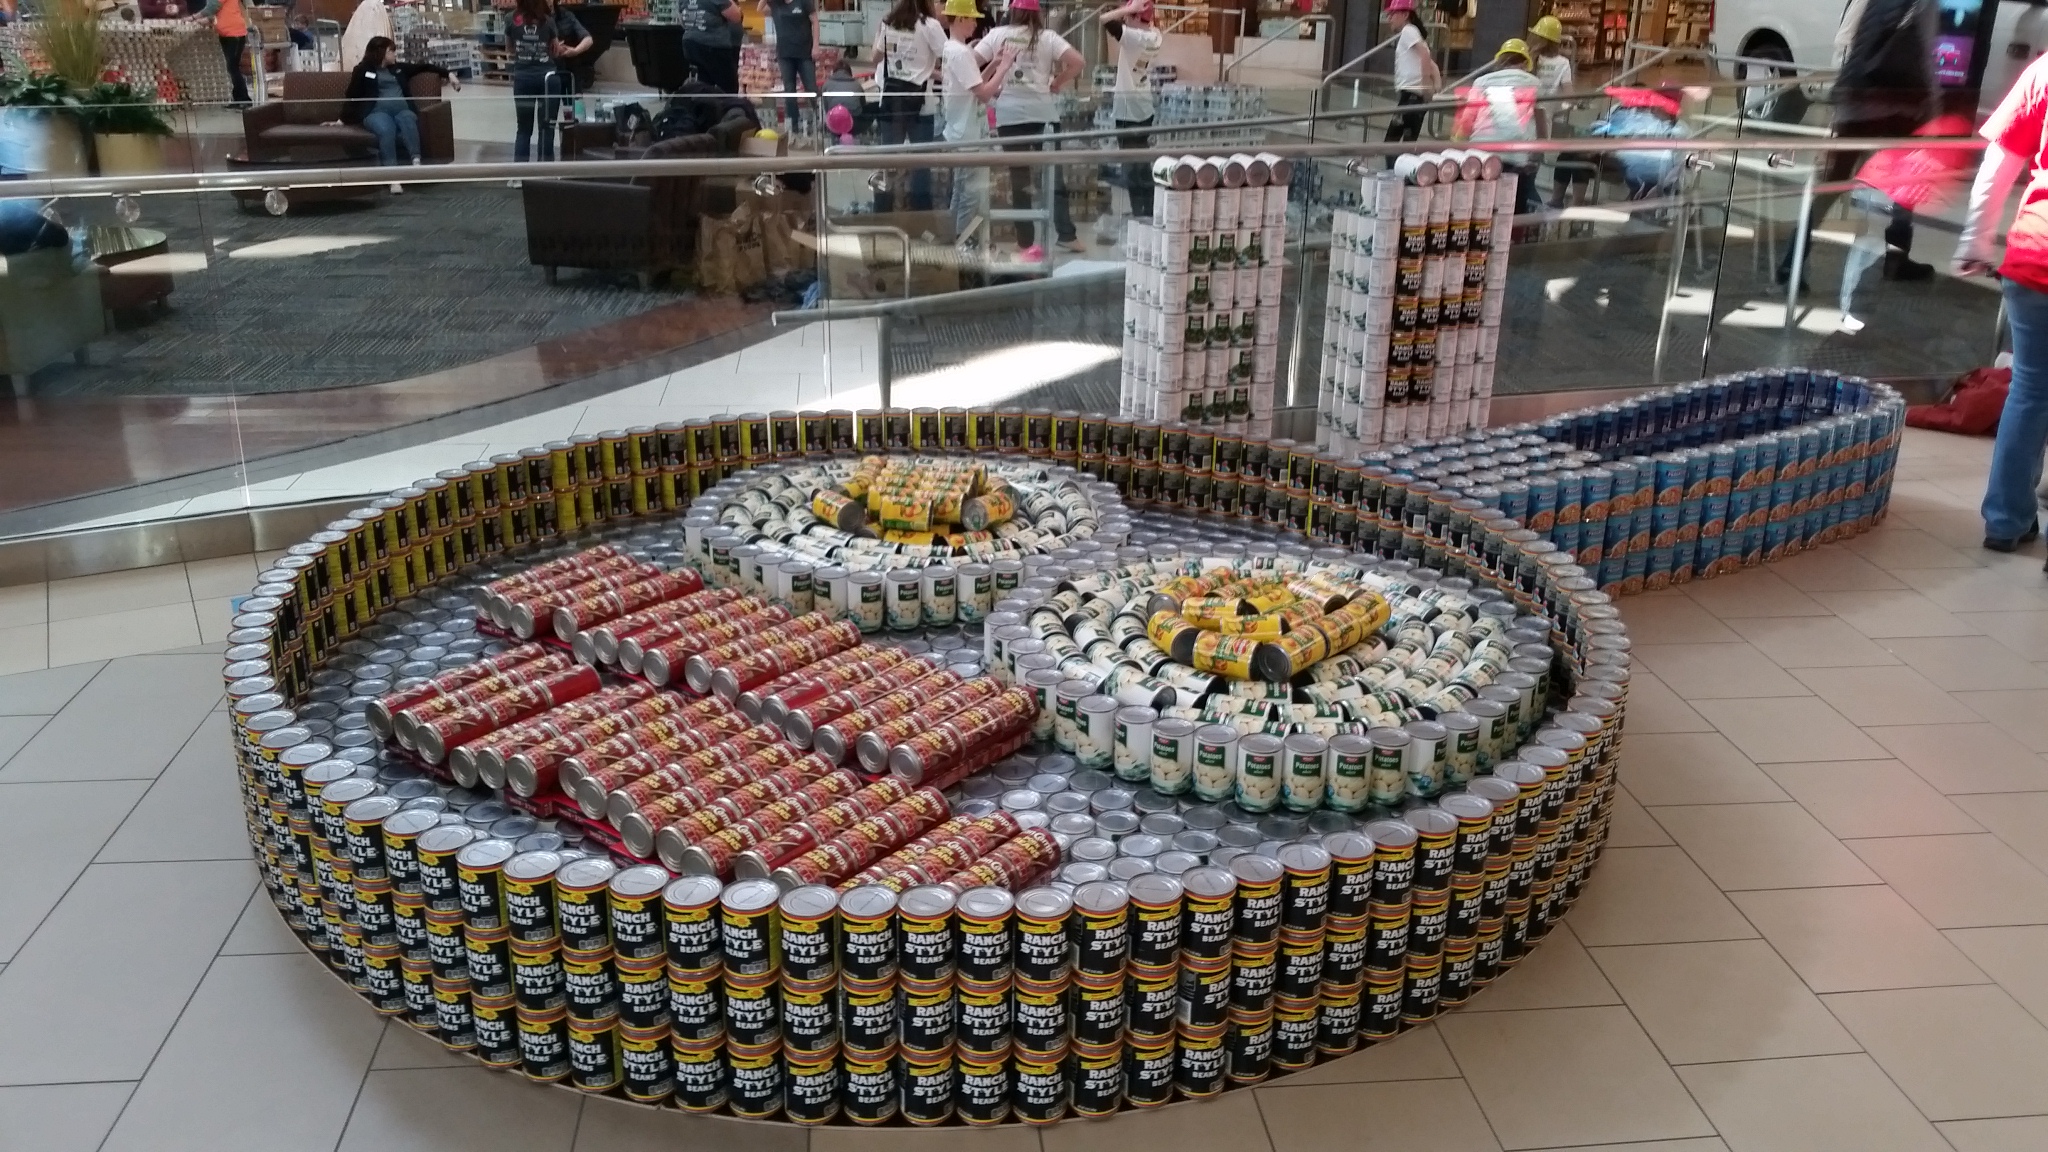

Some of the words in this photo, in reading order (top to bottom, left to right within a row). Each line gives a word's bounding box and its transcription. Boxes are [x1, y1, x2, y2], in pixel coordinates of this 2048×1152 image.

[1247, 762, 1271, 770] Potatoes
[1295, 762, 1320, 770] Potatoes
[1339, 762, 1363, 770] Potatoes
[1374, 755, 1399, 763] Potatoes
[1195, 908, 1233, 923] RANCH
[671, 918, 715, 934] RANCH
[617, 933, 642, 942] BEANS
[669, 929, 718, 943] STYLE
[783, 929, 824, 944] RANCH
[850, 929, 892, 944] RANCH
[907, 929, 950, 944] RANCH
[965, 930, 1008, 945] RANCH
[1023, 931, 1066, 945] RANCH
[1142, 928, 1180, 942] STYL
[1202, 933, 1227, 942] BEANS
[680, 943, 708, 953] BEANS
[782, 940, 828, 955] STYLE
[847, 939, 895, 954] STYLE
[905, 939, 952, 954] STYLE
[963, 942, 1010, 956] STYLE
[1020, 941, 1068, 956] STYLE
[1090, 936, 1127, 950] STYL
[789, 954, 816, 964] BEANS
[858, 954, 886, 964] BEANS
[916, 954, 943, 964] BEANS
[973, 955, 1001, 965] BEANS
[1031, 957, 1058, 965] BEANS
[517, 961, 560, 976] RANCH
[516, 971, 565, 986] STYLE
[567, 972, 608, 986] RANCH
[624, 978, 667, 993] RANCH
[525, 986, 553, 995] BEANS
[565, 983, 614, 996] STYLE
[574, 995, 601, 1004] BEANS
[671, 992, 713, 1005] RANCH
[728, 997, 771, 1011] RANCH
[633, 1002, 661, 1013] BEANS
[670, 1001, 717, 1015] STYLE
[727, 1007, 774, 1021] STYLE
[786, 1001, 828, 1016] RANCH
[965, 1003, 1007, 1017] RANCH
[1020, 1003, 1062, 1017] RANCH
[678, 1015, 705, 1024] BEANS
[735, 1021, 763, 1030] BEANS
[784, 1012, 831, 1026] STYLE
[912, 1012, 953, 1027] STYL
[962, 1013, 1010, 1027] STYLE
[1017, 1013, 1064, 1027] STYLE
[793, 1026, 820, 1035] BEANS
[865, 1023, 892, 1035] BEANS
[973, 1027, 1000, 1035] BEANS
[1027, 1027, 1054, 1035] BEANS
[1185, 1046, 1224, 1060] RANCH
[678, 1058, 721, 1074] RANCH
[735, 1065, 778, 1079] RANCH
[630, 1072, 656, 1081] BEANS
[676, 1068, 724, 1084] STYLE
[733, 1073, 781, 1088] STYLE
[796, 1068, 837, 1085] RANCH
[850, 1070, 892, 1085] RANCH
[965, 1072, 1007, 1087] RANCH
[1020, 1072, 1061, 1087] RANCH
[1192, 1070, 1218, 1079] BEANS
[686, 1084, 714, 1092] BEANS
[744, 1088, 772, 1098] BEANS
[847, 1080, 895, 1096] STYLE
[913, 1081, 952, 1097] STYL
[962, 1081, 1008, 1097] STYLE
[1017, 1083, 1064, 1097] STYLE
[805, 1093, 831, 1105] BEANS
[858, 1095, 885, 1104] BEANS
[972, 1097, 999, 1105] BEANS
[1027, 1097, 1054, 1105] BEANS
